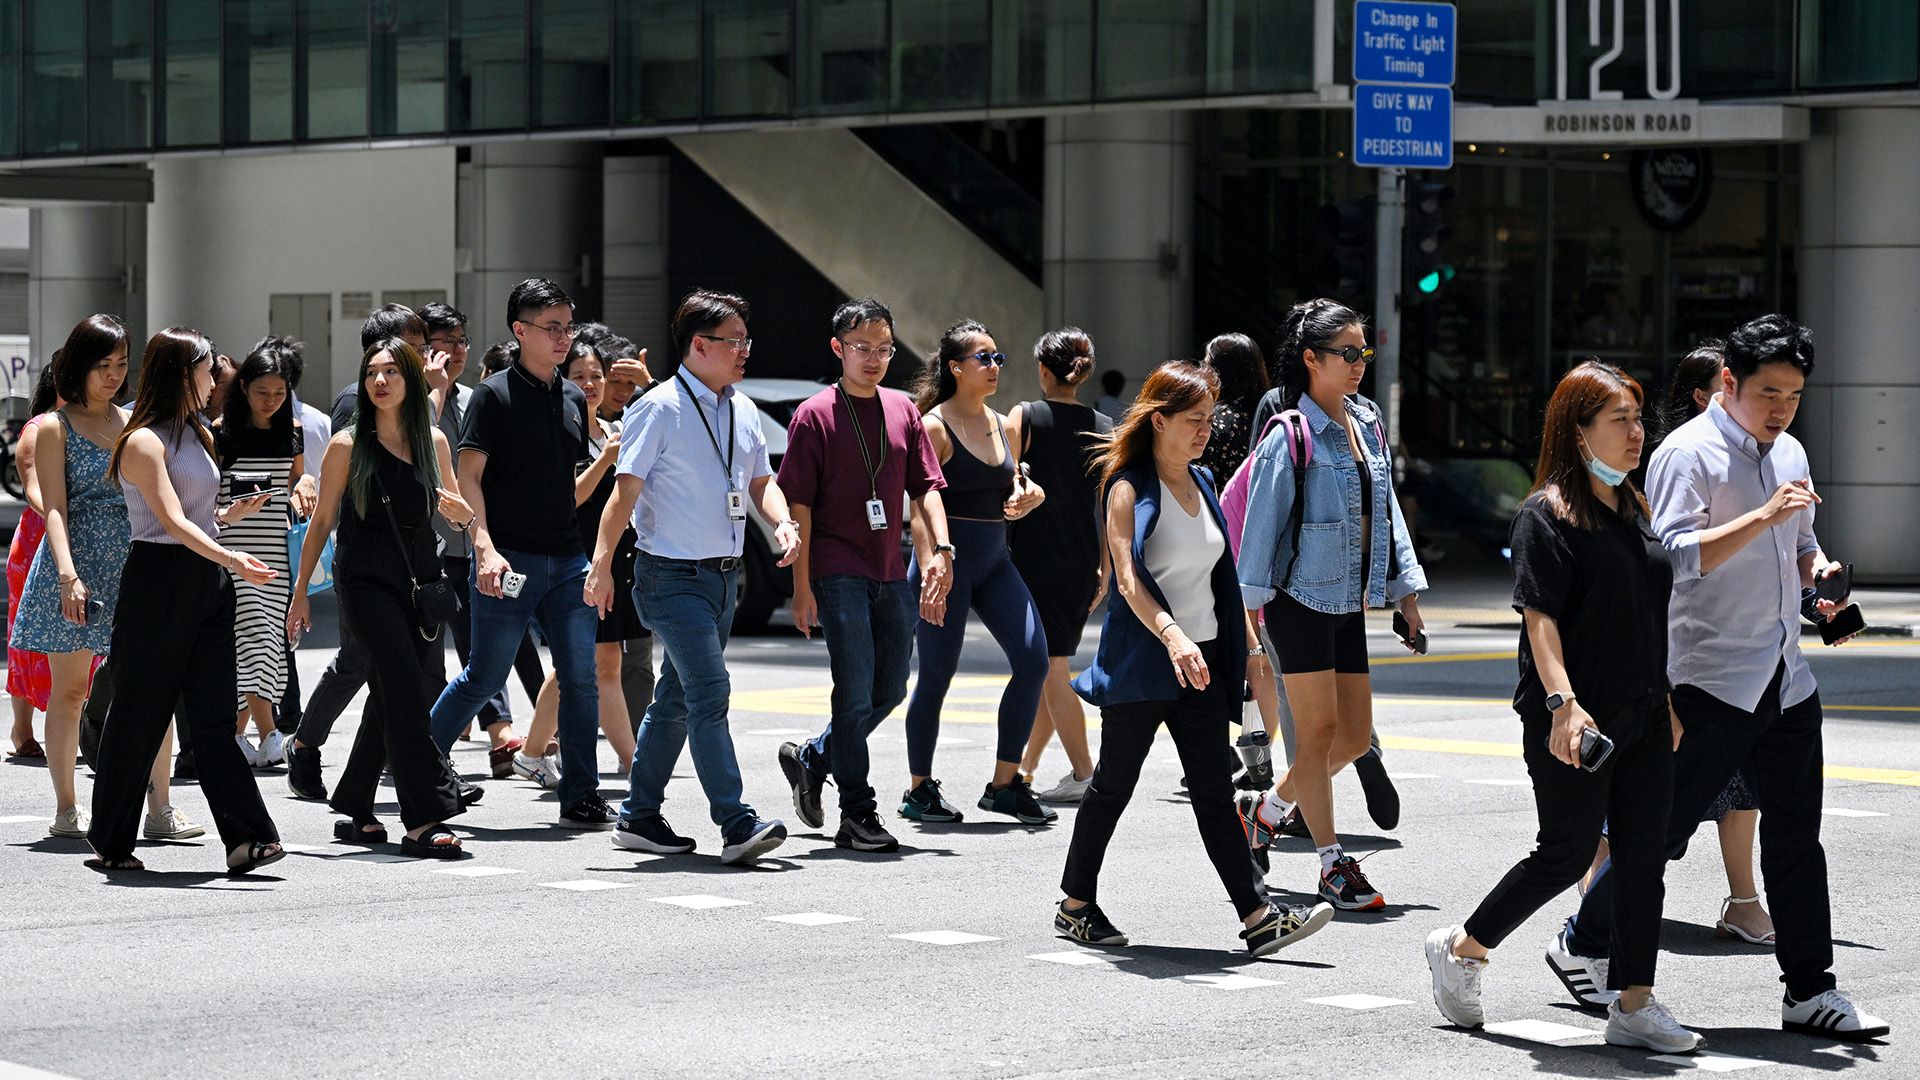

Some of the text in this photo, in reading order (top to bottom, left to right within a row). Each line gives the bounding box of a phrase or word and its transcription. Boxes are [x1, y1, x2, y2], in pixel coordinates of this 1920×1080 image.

[1371, 9, 1438, 31] Change In
[1363, 32, 1446, 55] Traffic Light
[1556, 0, 1681, 100] 120
[1384, 56, 1424, 78] Timing
[1372, 93, 1434, 110] GIVE WAY
[1395, 116, 1412, 133] TO
[1545, 114, 1692, 132] ROBINSON ROAD
[1363, 138, 1443, 157] PEDESTRIAN
